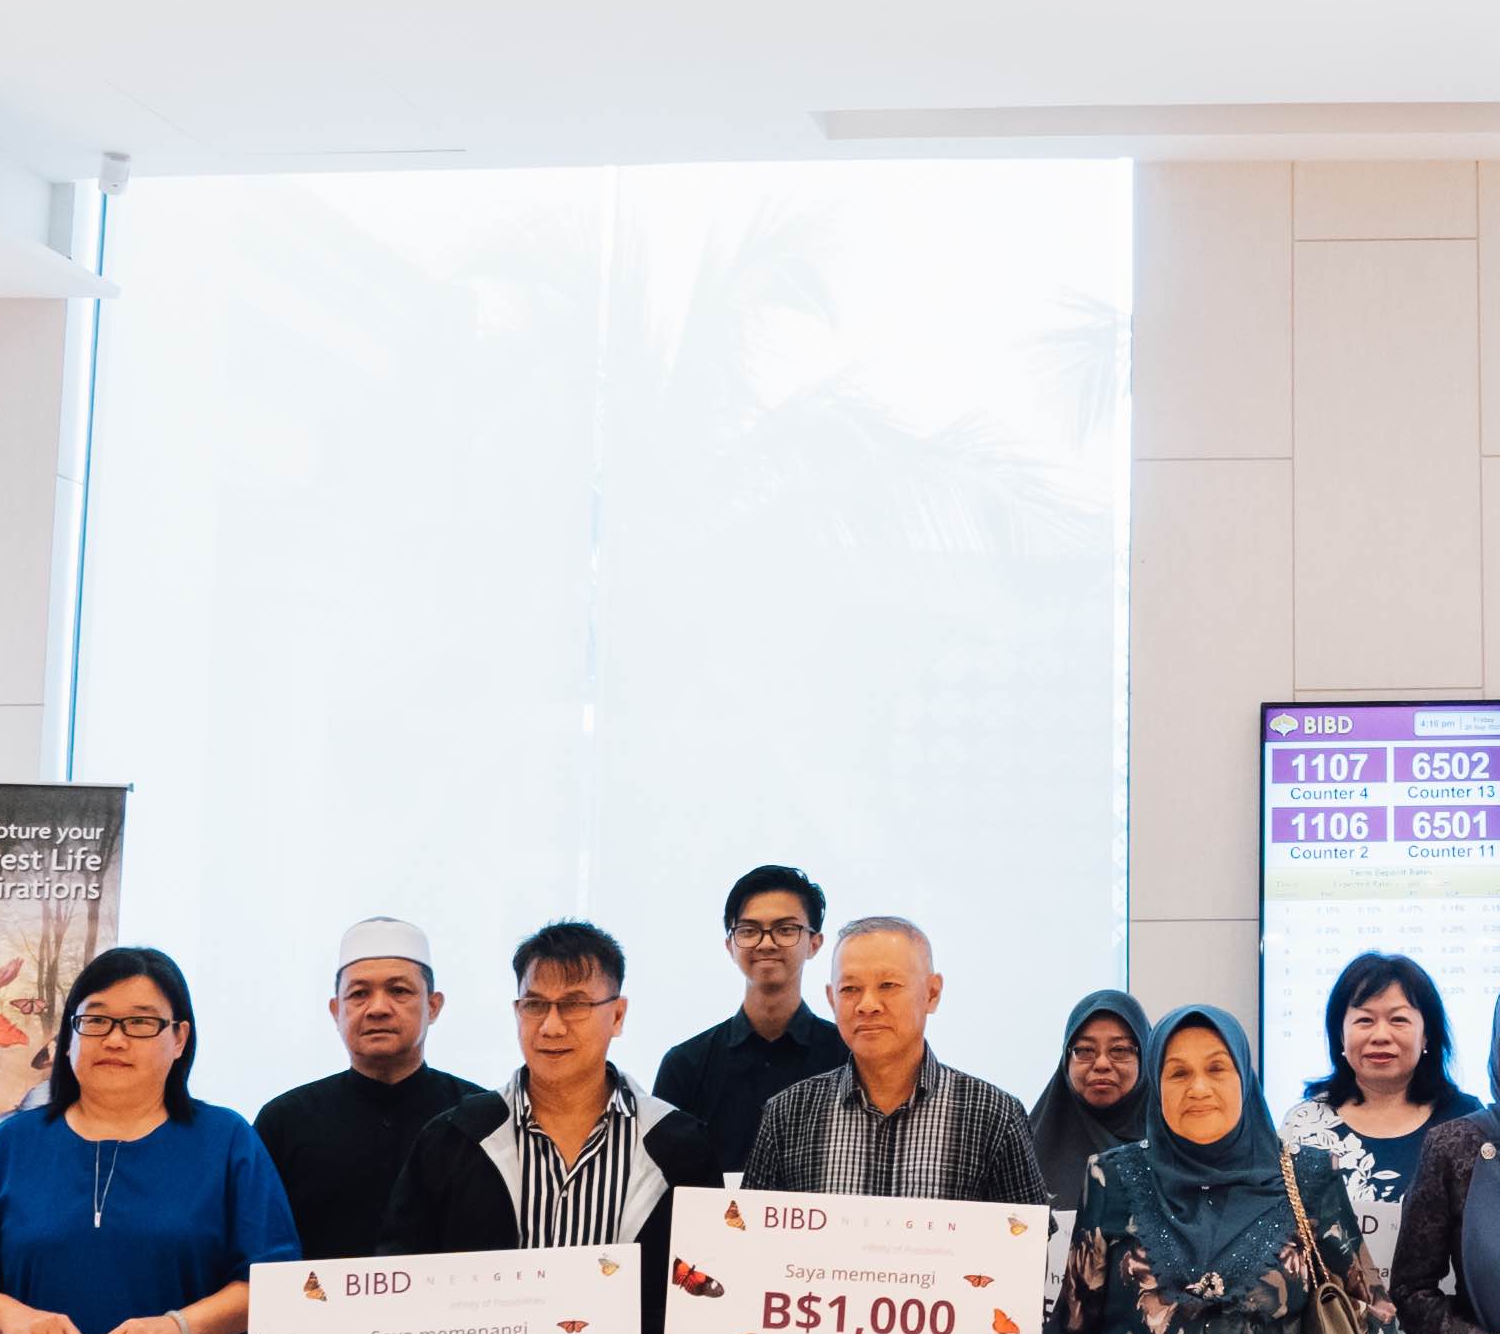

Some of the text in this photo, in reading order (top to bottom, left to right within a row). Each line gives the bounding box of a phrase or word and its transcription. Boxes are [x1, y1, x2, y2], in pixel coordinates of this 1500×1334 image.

[1304, 716, 1353, 734] BIBD
[1291, 753, 1368, 781] 1107
[1412, 752, 1490, 780] 6502
[1290, 788, 1369, 800] Counter 4
[1407, 786, 1495, 799] Counter 13
[57, 824, 104, 844] your
[1291, 812, 1369, 840] 1106
[1412, 811, 1488, 839] 6501
[51, 849, 102, 871] Life
[1290, 847, 1369, 859] Counter 2
[1408, 845, 1495, 858] Counter 11
[765, 1207, 827, 1230] BIBD
[346, 1271, 412, 1297] BIBD
[785, 1264, 935, 1289] Saya memenangi
